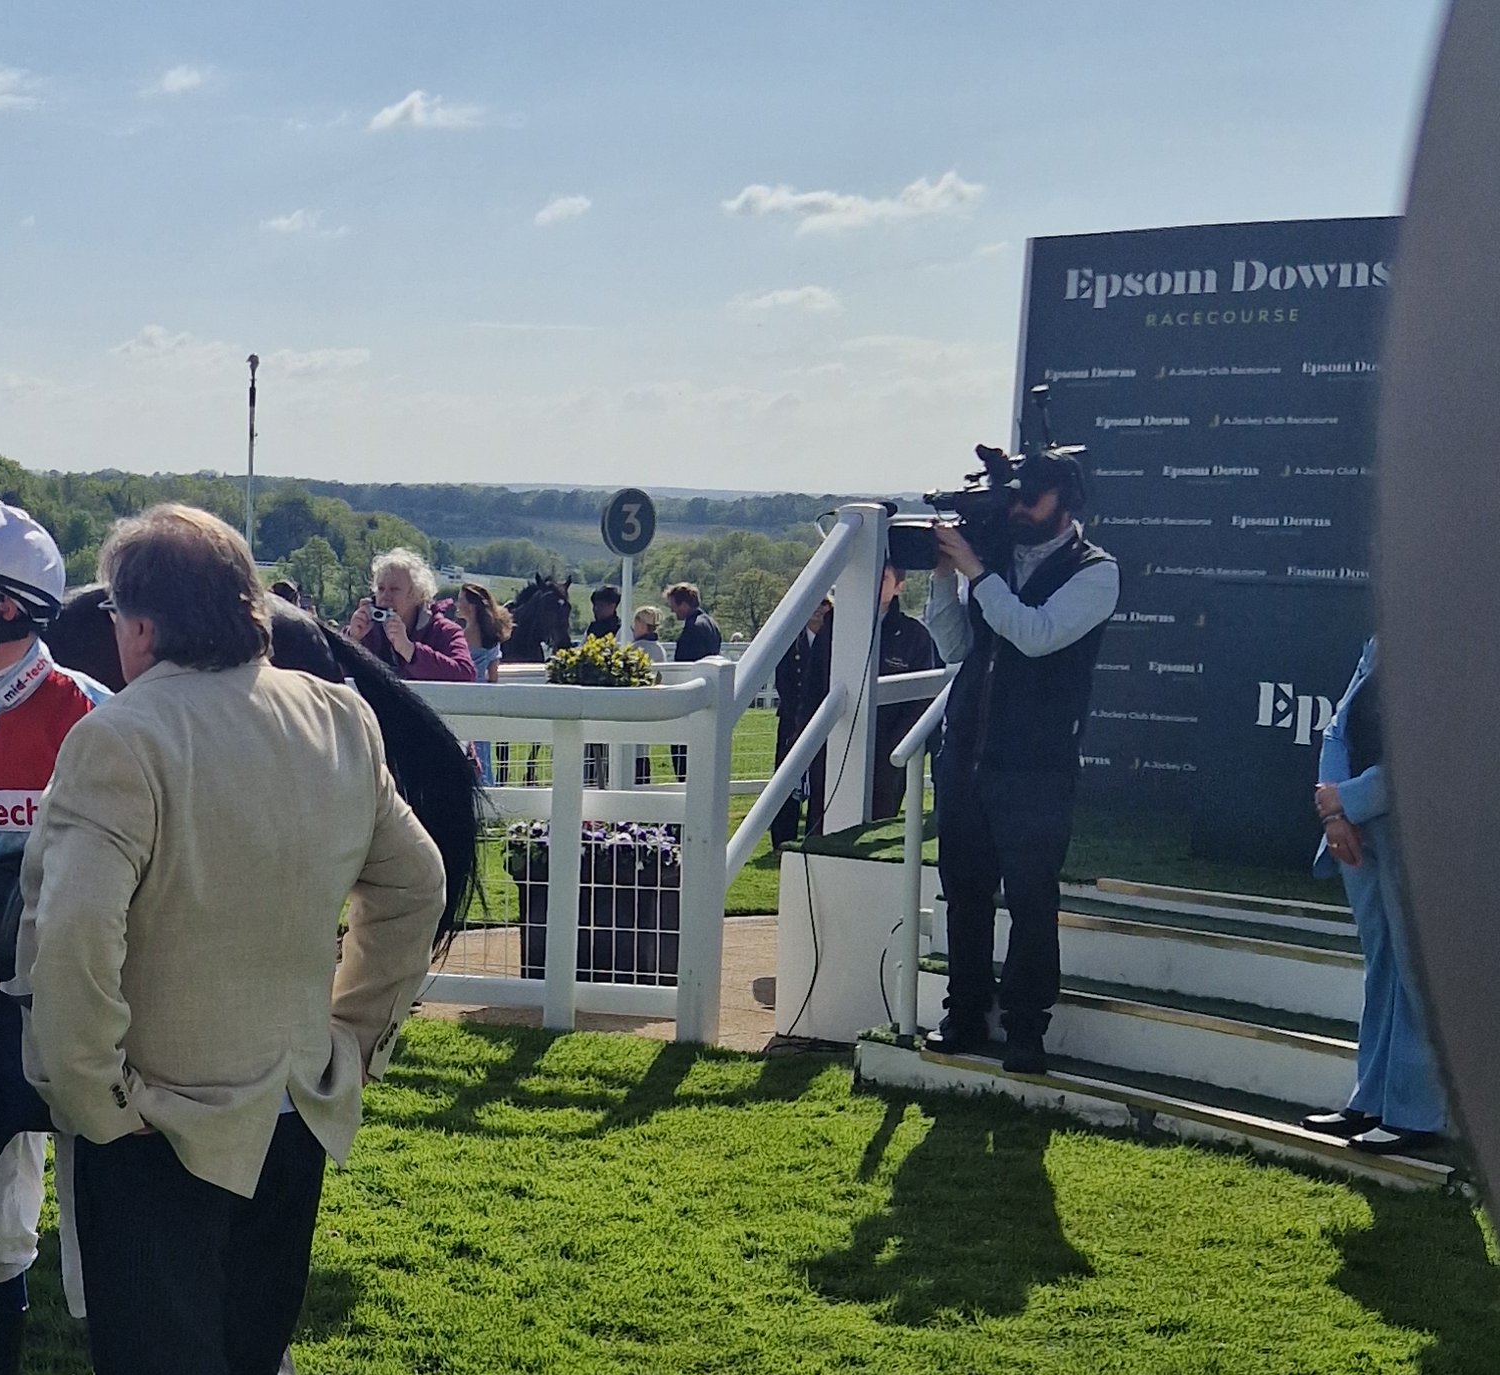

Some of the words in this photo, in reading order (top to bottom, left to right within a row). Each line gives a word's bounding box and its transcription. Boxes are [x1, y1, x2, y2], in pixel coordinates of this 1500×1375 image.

[1064, 268, 1217, 309] Epsom
[1231, 260, 1390, 293] Downs
[1145, 308, 1299, 328] RACECOURSE
[1044, 368, 1089, 382] Epsom
[1091, 367, 1137, 379] Downs
[1302, 361, 1351, 376] Epsom
[1096, 416, 1141, 429] Epsom
[1143, 415, 1190, 427] Downs
[1264, 416, 1285, 425] Club
[1286, 416, 1339, 425] Racecourse
[1162, 465, 1209, 479] Epsom
[1211, 465, 1260, 477] Downs
[1303, 467, 1335, 476] Jockey
[1336, 467, 1358, 475] Club
[621, 503, 642, 542] 3
[1231, 515, 1279, 529] Epsom
[1283, 516, 1331, 527] Downs
[1130, 611, 1175, 623] Downs
[1149, 661, 1195, 674] Epsom
[3, 658, 49, 703] mid-tech
